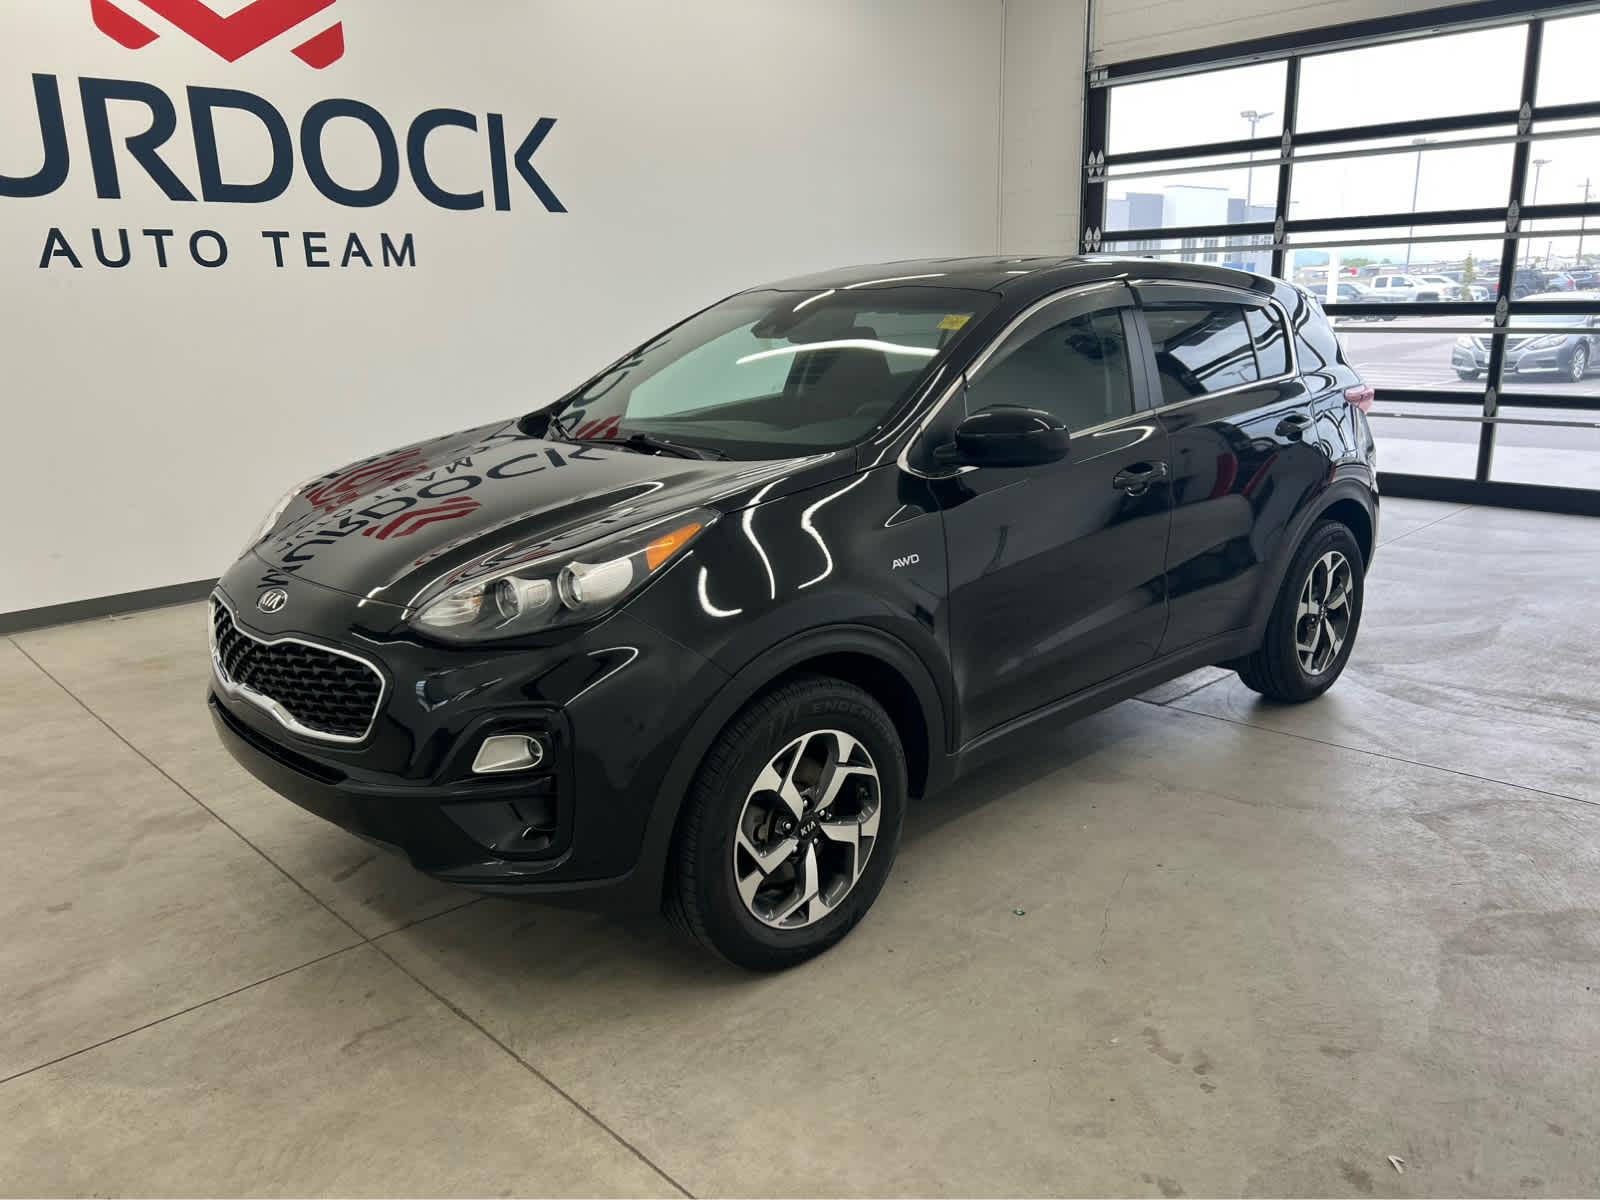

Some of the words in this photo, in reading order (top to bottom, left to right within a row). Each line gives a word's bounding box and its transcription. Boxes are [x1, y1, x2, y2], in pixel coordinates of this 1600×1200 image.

[38, 227, 229, 269] AUTO
[261, 230, 417, 268] TEAM
[892, 553, 920, 570] AWD
[259, 590, 284, 611] KIA
